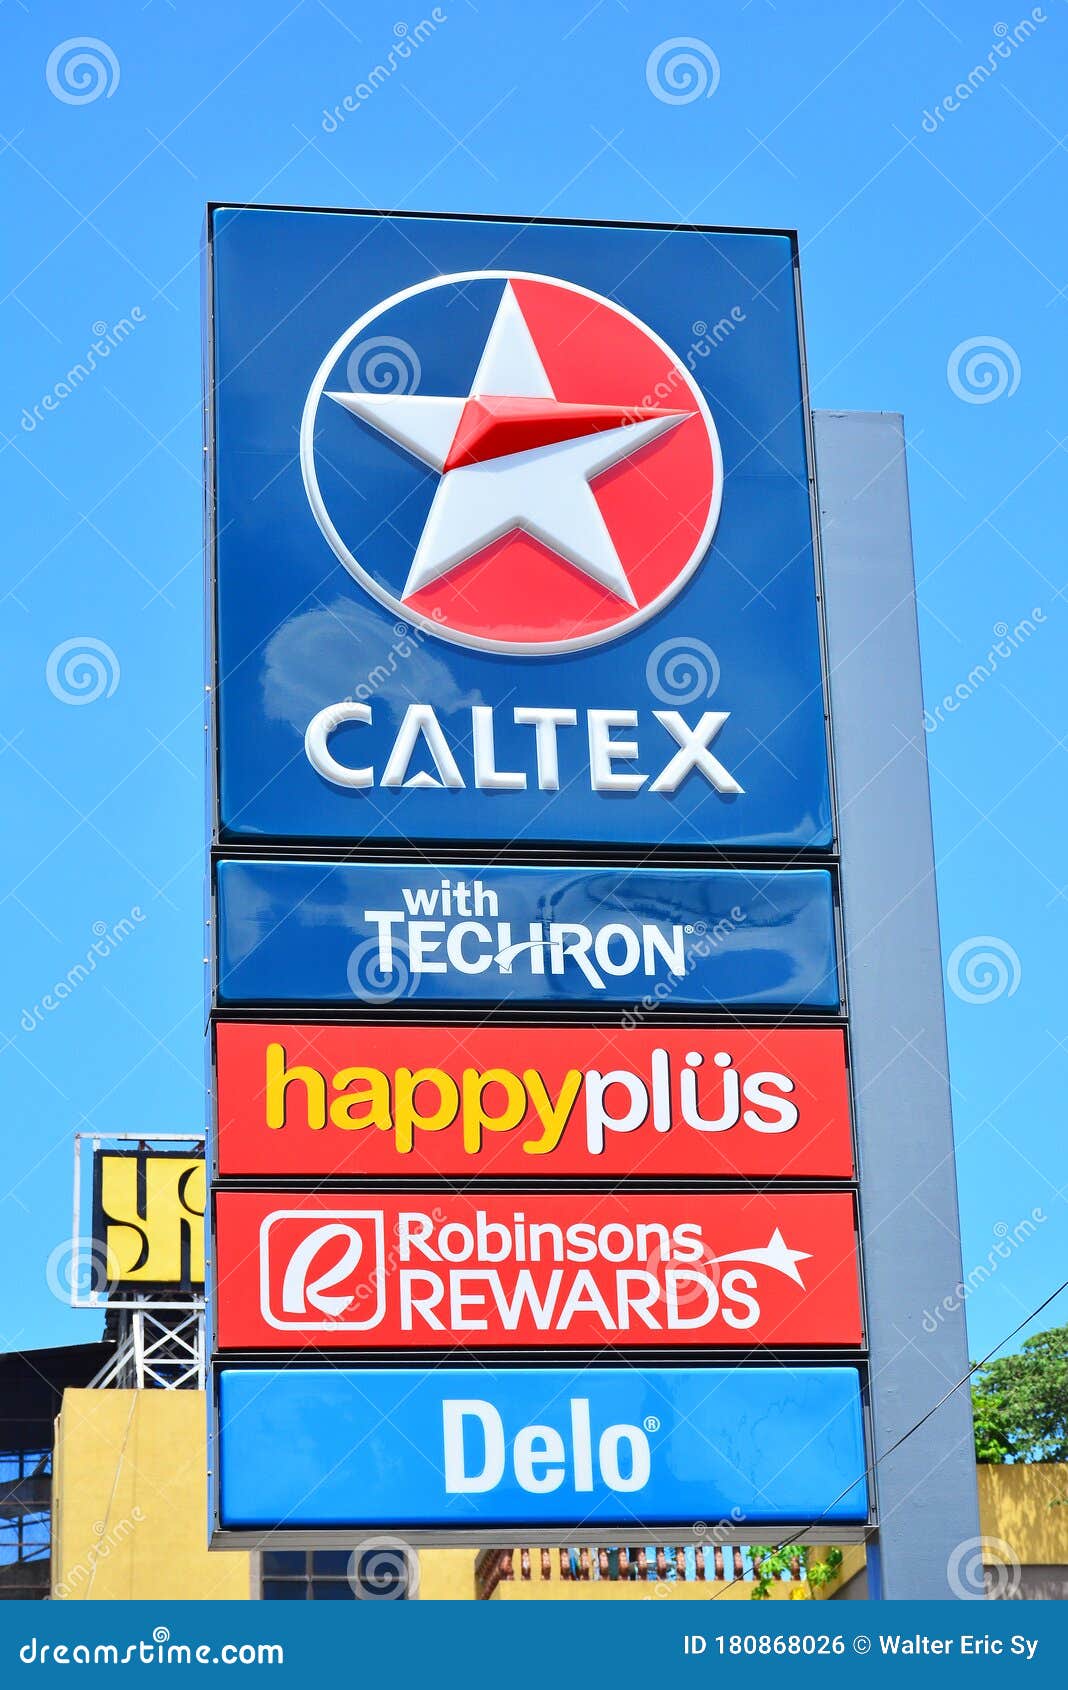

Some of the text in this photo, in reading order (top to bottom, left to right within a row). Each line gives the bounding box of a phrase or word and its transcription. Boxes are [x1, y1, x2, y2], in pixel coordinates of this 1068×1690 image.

[305, 702, 746, 794] CALTEX
[402, 880, 498, 916] with
[266, 1043, 799, 1154] happyplüs
[399, 1211, 703, 1262] Robinsons
[400, 1269, 761, 1332] REWARDS
